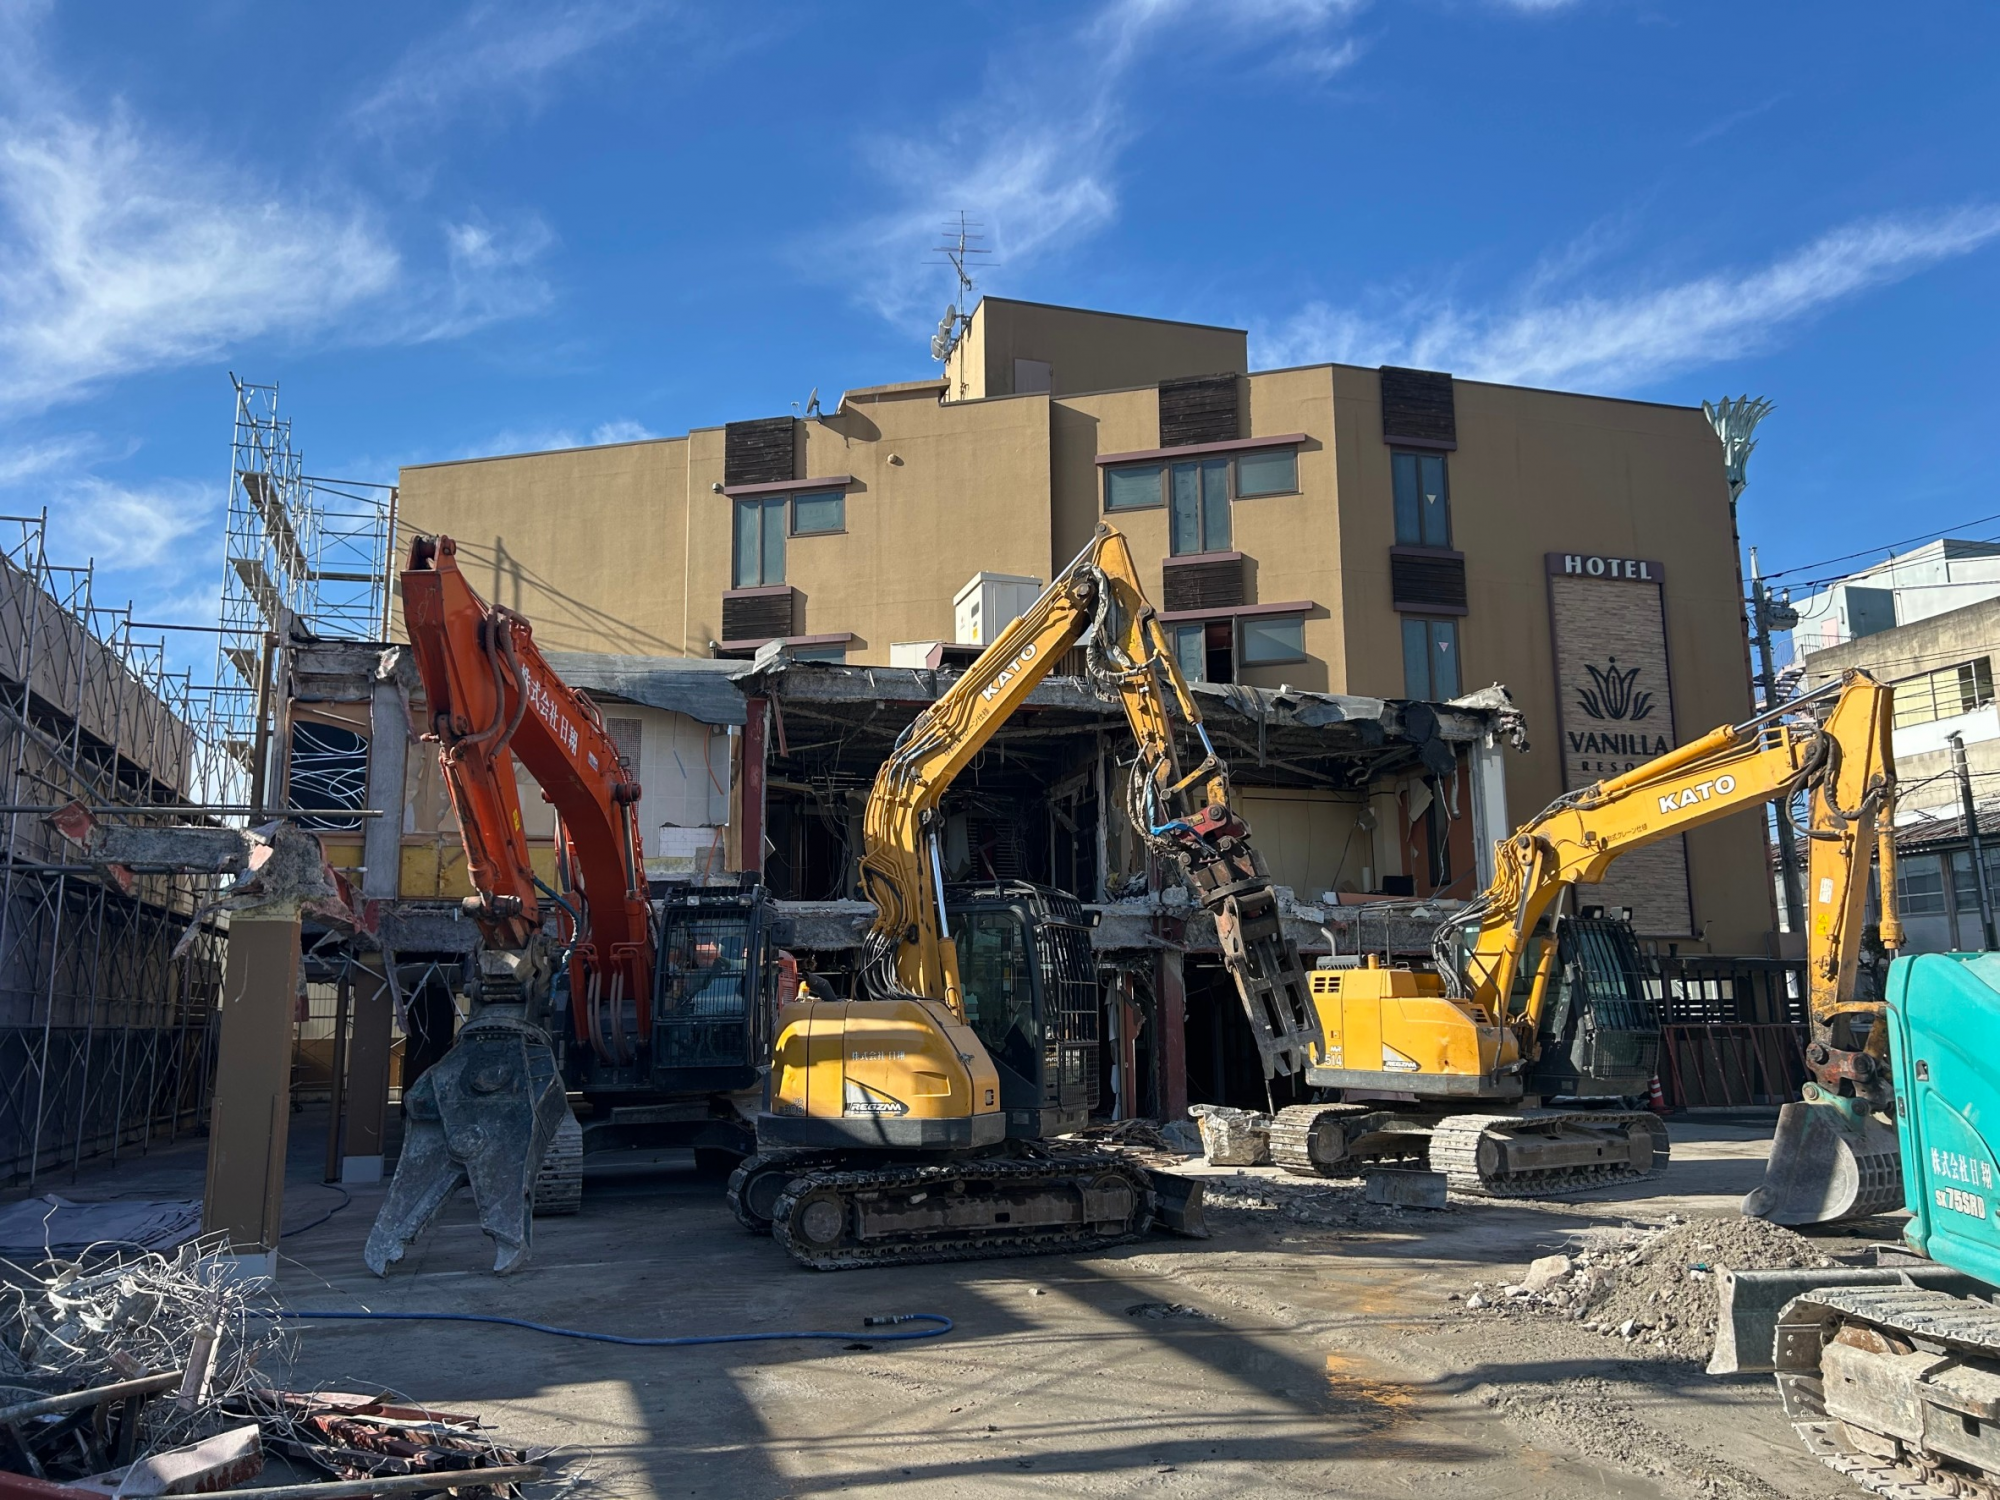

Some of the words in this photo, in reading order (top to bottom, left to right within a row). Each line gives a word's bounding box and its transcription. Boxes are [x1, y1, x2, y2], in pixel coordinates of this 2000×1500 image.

[1565, 555, 1652, 579] HOTEL
[981, 643, 1037, 702] KATO
[1567, 731, 1670, 756] VANILLA
[1582, 761, 1635, 773] RESO
[1658, 775, 1736, 814] KATO
[850, 1102, 902, 1111] REGZAM
[1930, 1147, 1970, 1183] 株式会社
